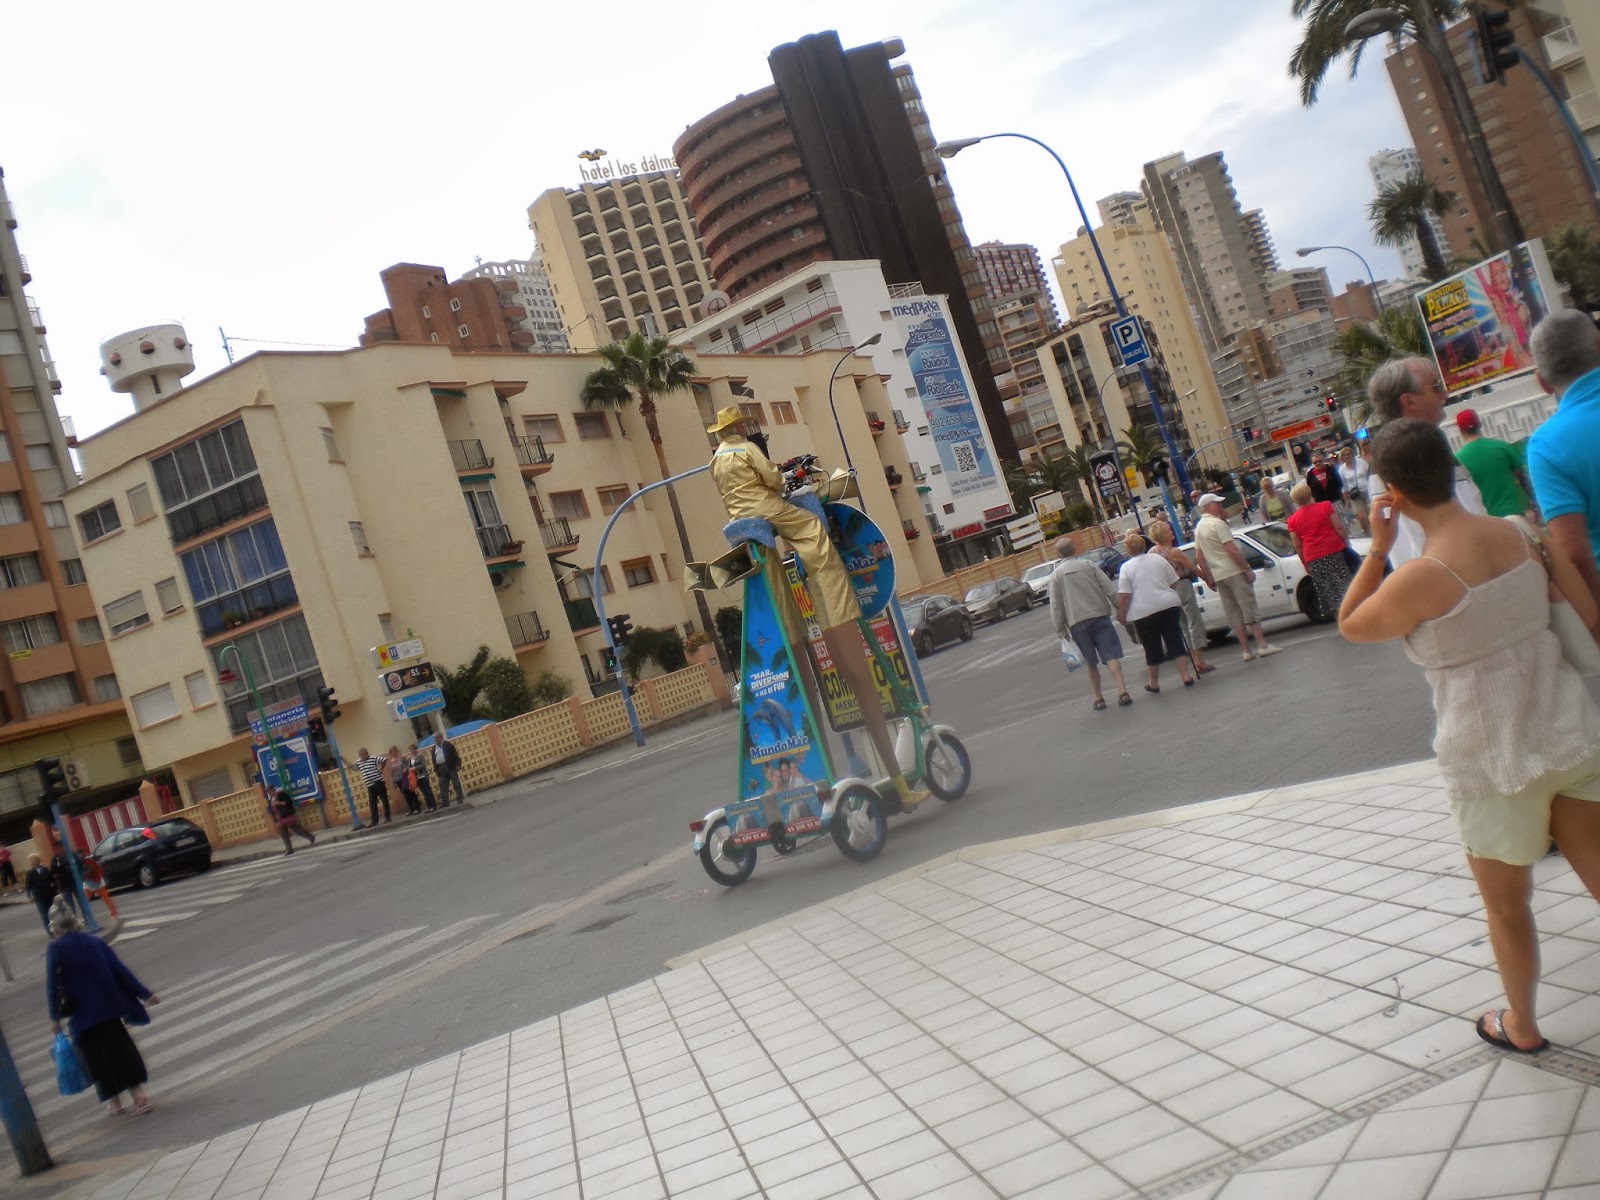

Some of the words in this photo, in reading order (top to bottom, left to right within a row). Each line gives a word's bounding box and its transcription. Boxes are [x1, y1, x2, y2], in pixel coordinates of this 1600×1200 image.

[579, 161, 614, 181] hotel
[616, 160, 637, 176] los
[909, 328, 945, 343] Regente
[1120, 325, 1133, 344] P
[921, 356, 950, 370] Riudor
[930, 417, 945, 428] 902
[750, 671, 789, 689] DIVERSION
[773, 681, 785, 692] FUN
[405, 695, 440, 708] MundoMar
[750, 735, 808, 759] MundoMar
